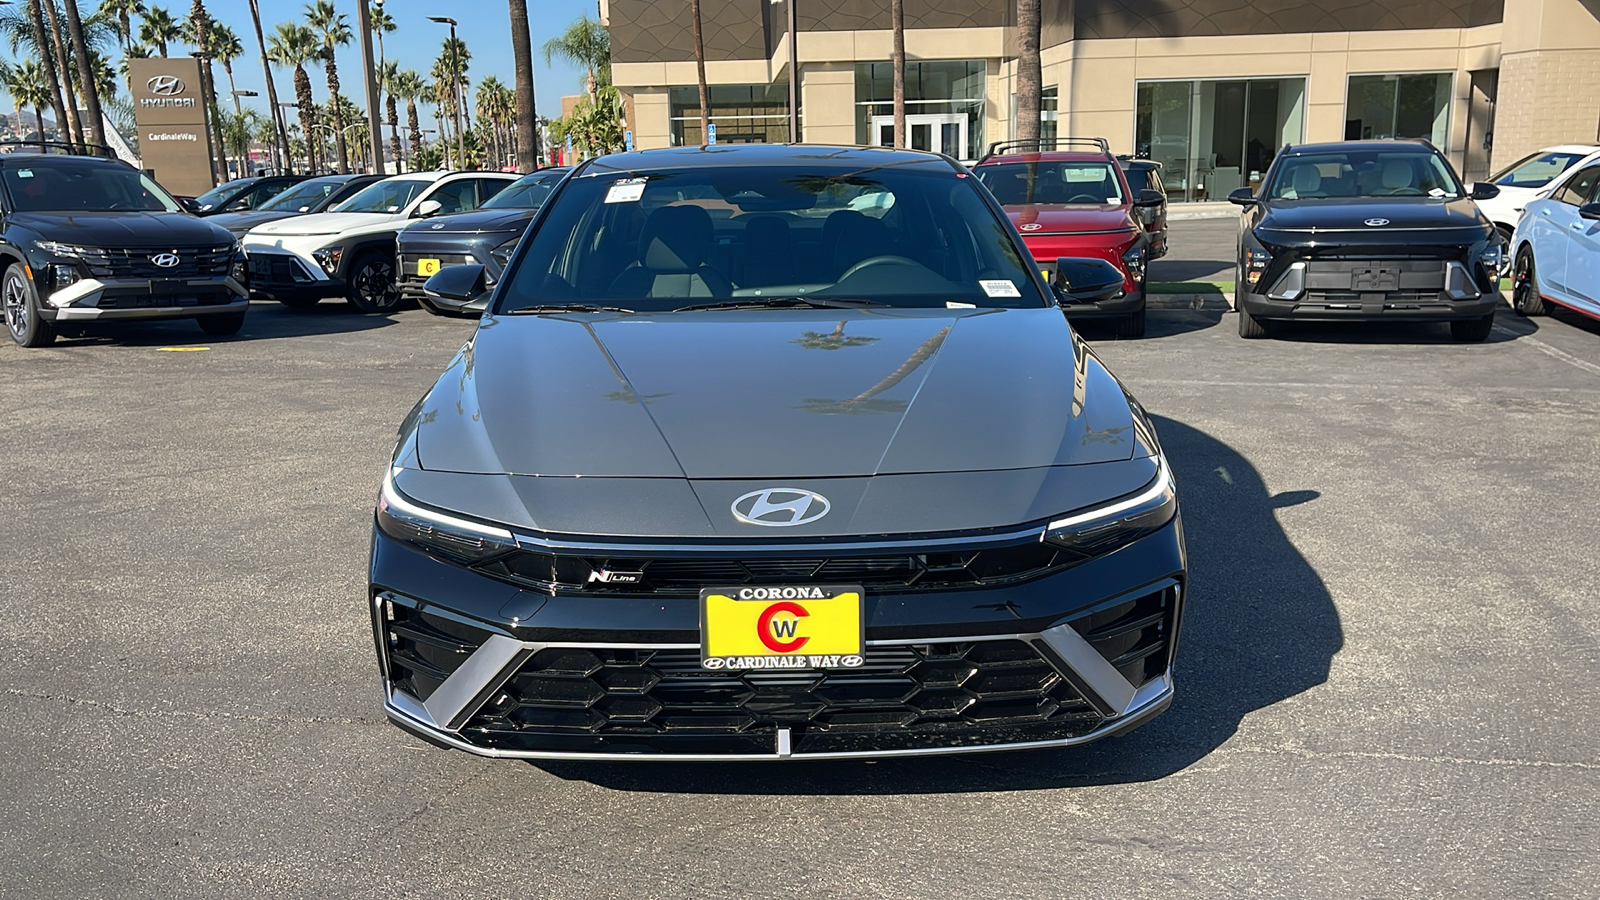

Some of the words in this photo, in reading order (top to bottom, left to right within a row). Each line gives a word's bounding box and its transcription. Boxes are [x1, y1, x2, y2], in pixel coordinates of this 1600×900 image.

[140, 98, 195, 108] HYUNDAI
[148, 133, 197, 141] CardinaleWay
[739, 587, 825, 600] CORONA
[726, 656, 807, 670] CARDINALE
[809, 655, 842, 668] WAY
